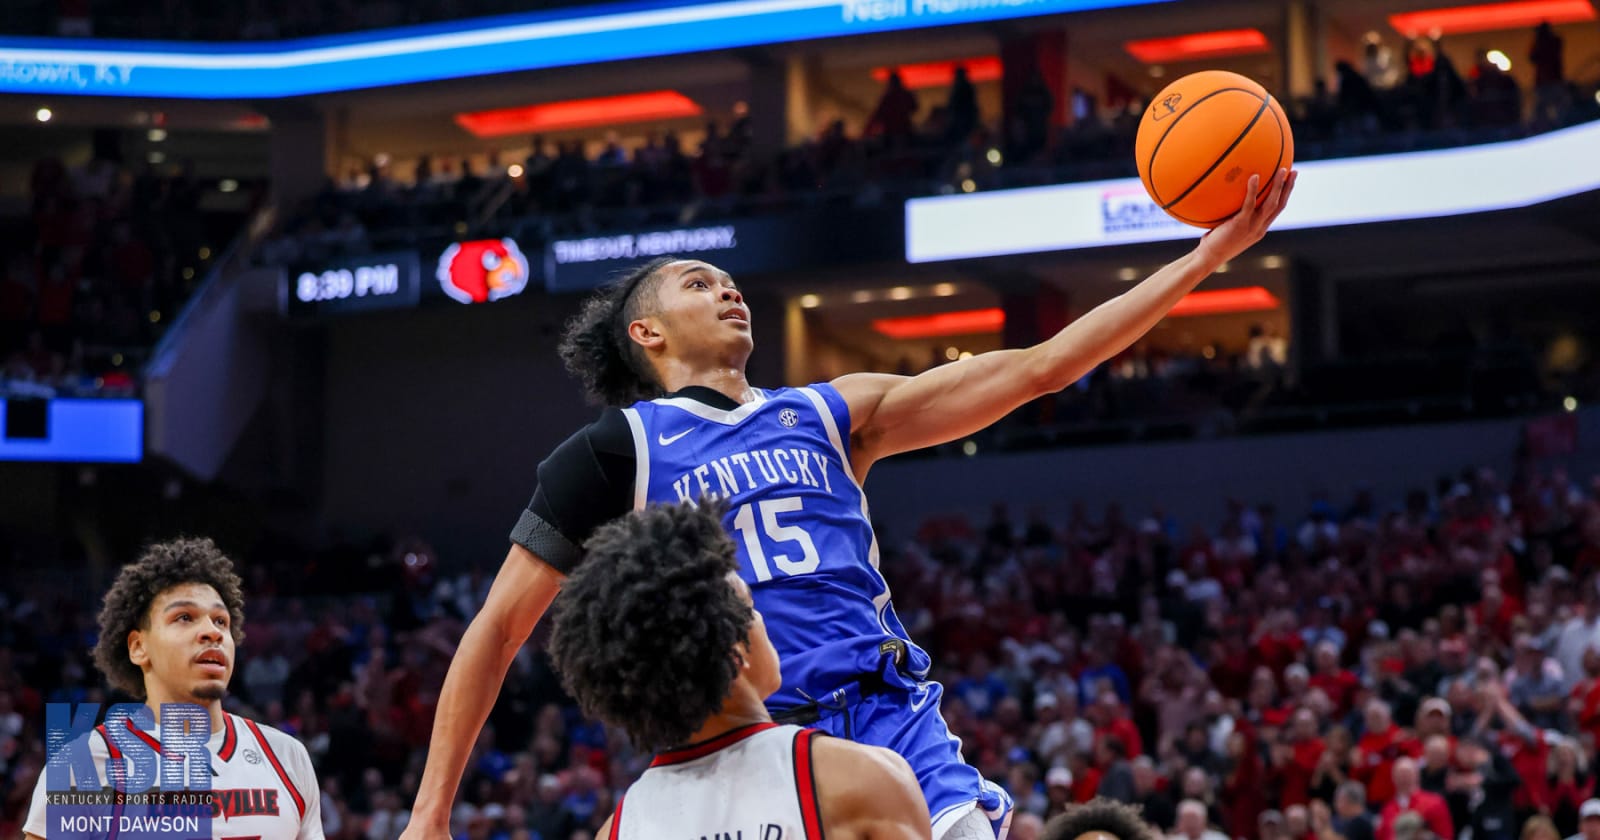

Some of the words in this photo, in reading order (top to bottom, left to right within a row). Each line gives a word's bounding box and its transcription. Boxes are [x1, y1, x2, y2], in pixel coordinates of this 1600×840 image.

[95, 63, 133, 84] KY
[355, 263, 398, 297] PM
[779, 409, 798, 427] SEC
[672, 448, 833, 510] KENTUCKY
[734, 496, 821, 582] 15
